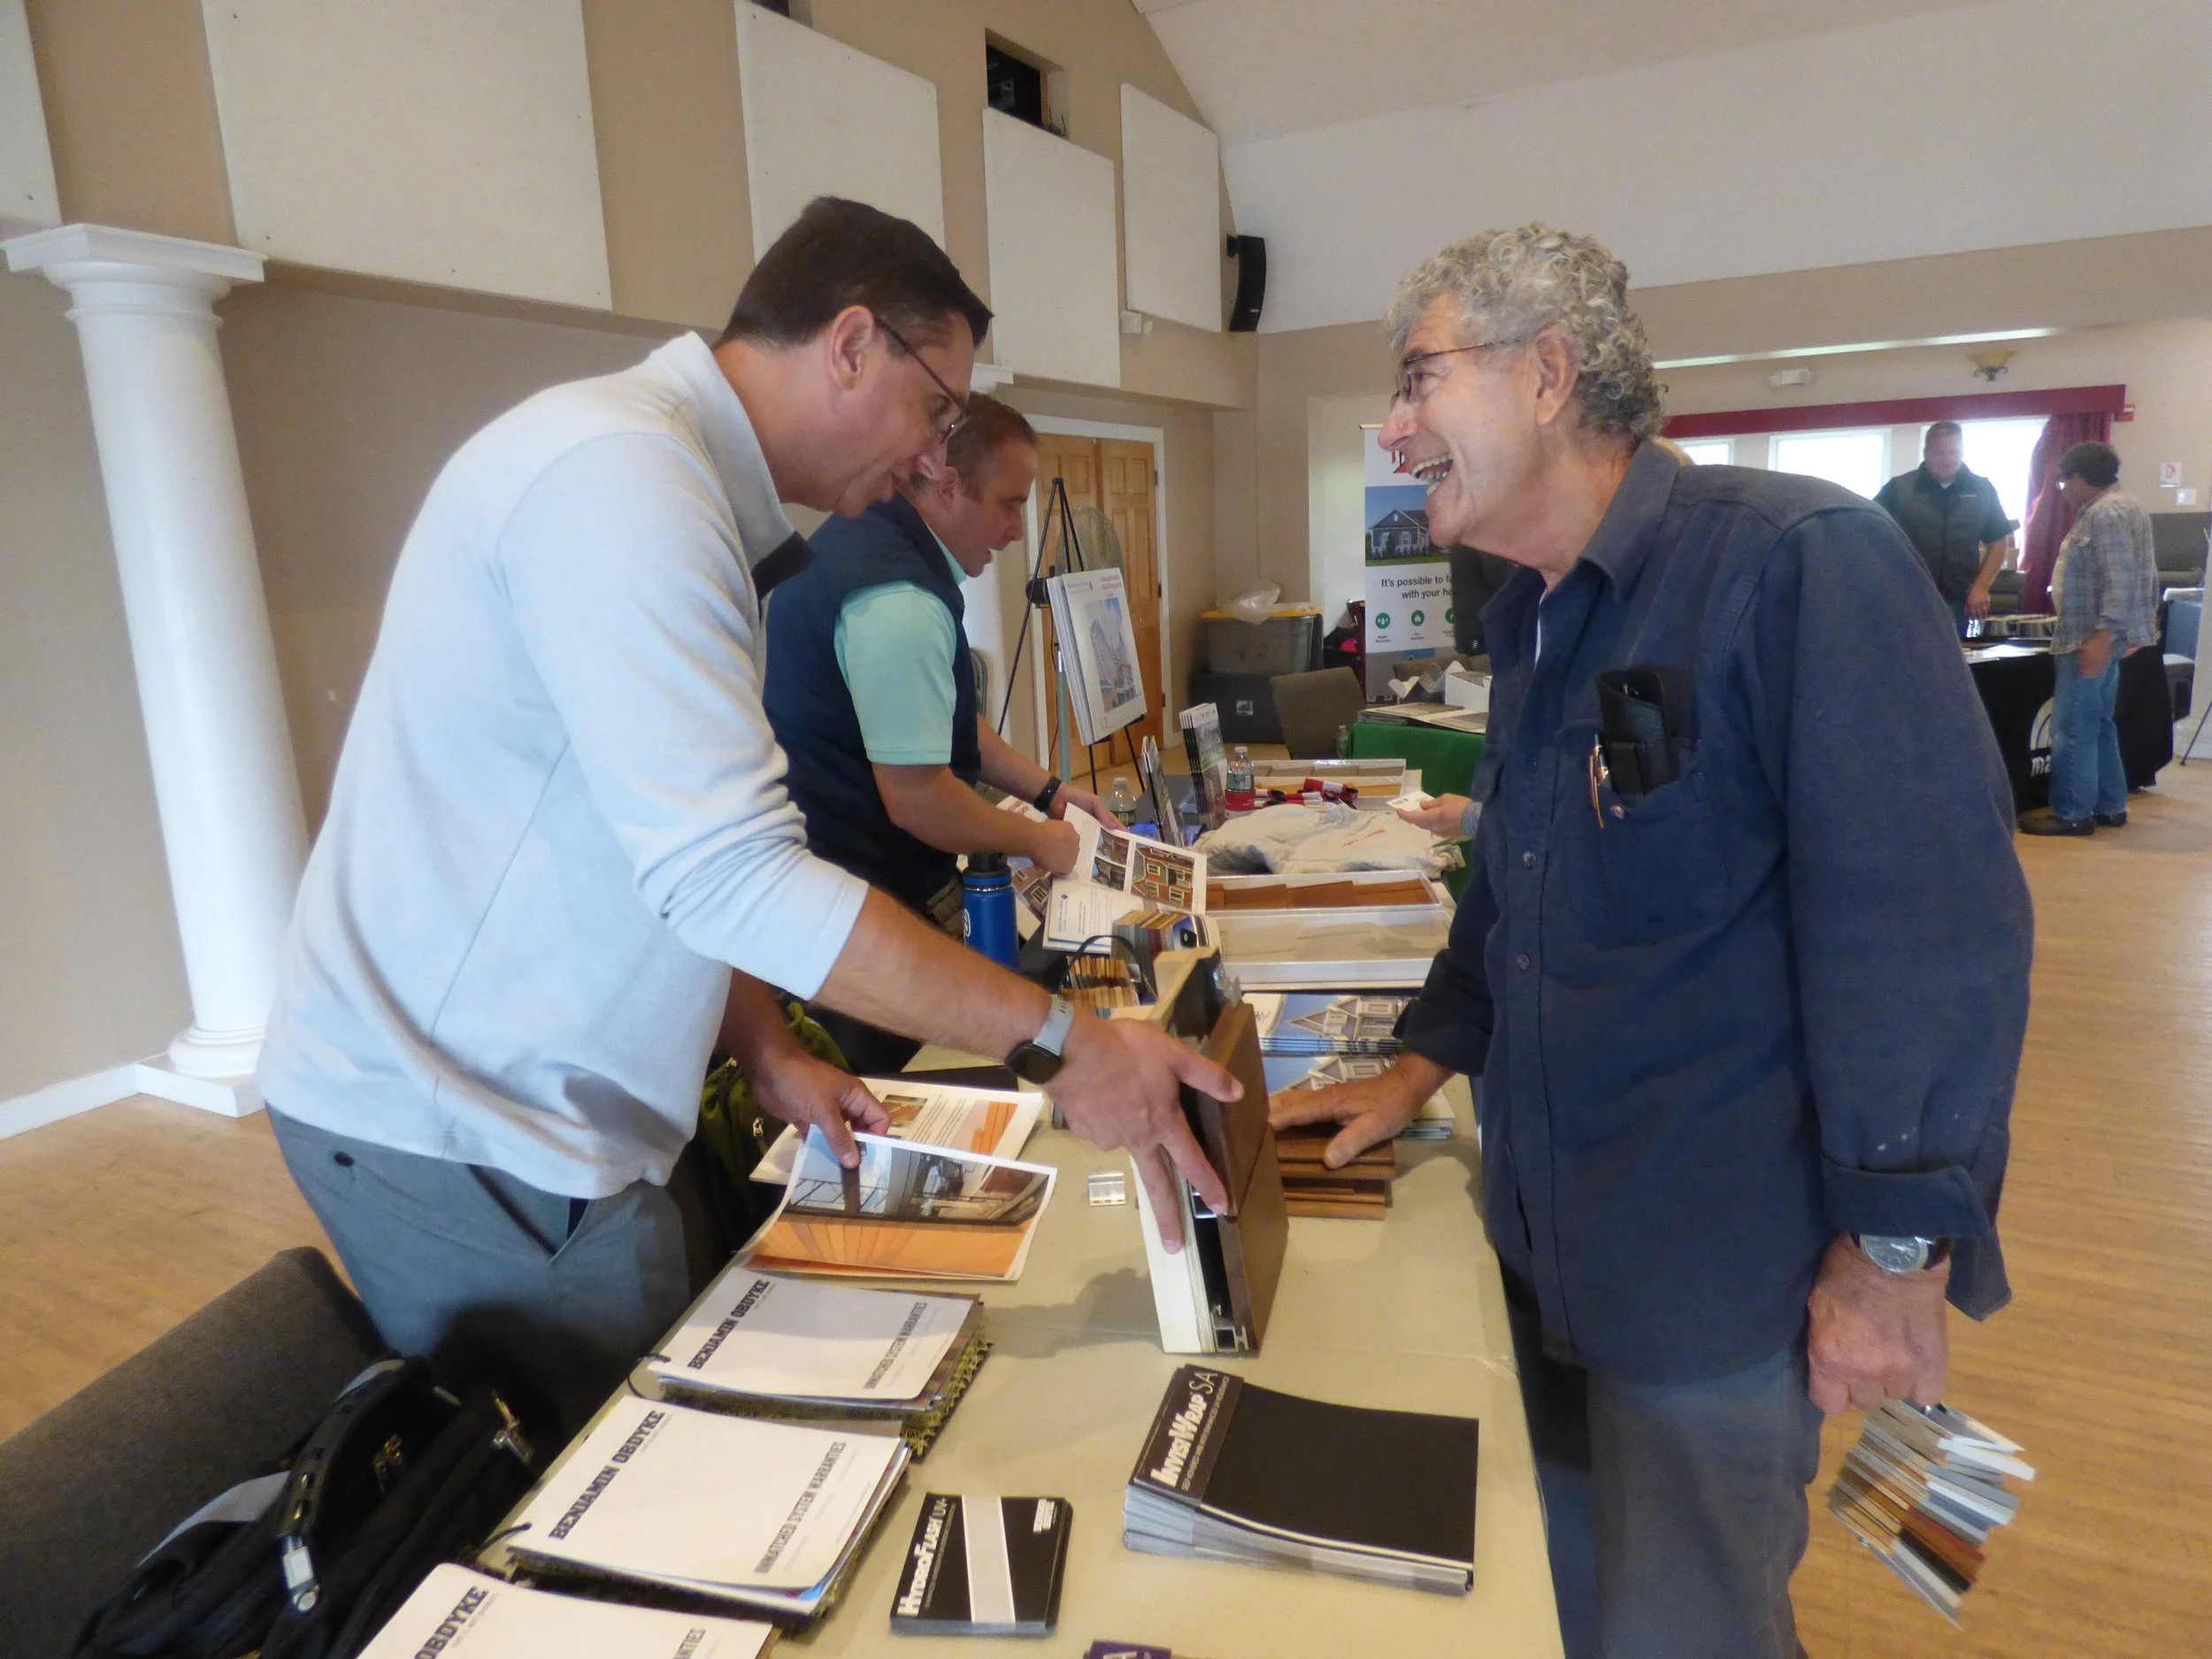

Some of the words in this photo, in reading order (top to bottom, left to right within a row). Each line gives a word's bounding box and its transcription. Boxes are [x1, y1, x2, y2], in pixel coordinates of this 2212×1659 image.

[1381, 579, 1395, 588] It's
[1397, 576, 1432, 588] possible
[1402, 590, 1420, 599] with
[1421, 590, 1441, 600] your
[687, 1318, 739, 1370] BENJAMIN
[730, 1279, 771, 1317] OBDYKE
[1189, 1372, 1218, 1394] SA
[548, 1464, 620, 1540] BENJAMIN
[611, 1410, 666, 1463] OBDYKE
[787, 1490, 818, 1523] SYSTEM
[807, 1441, 847, 1489] WARRANTIES
